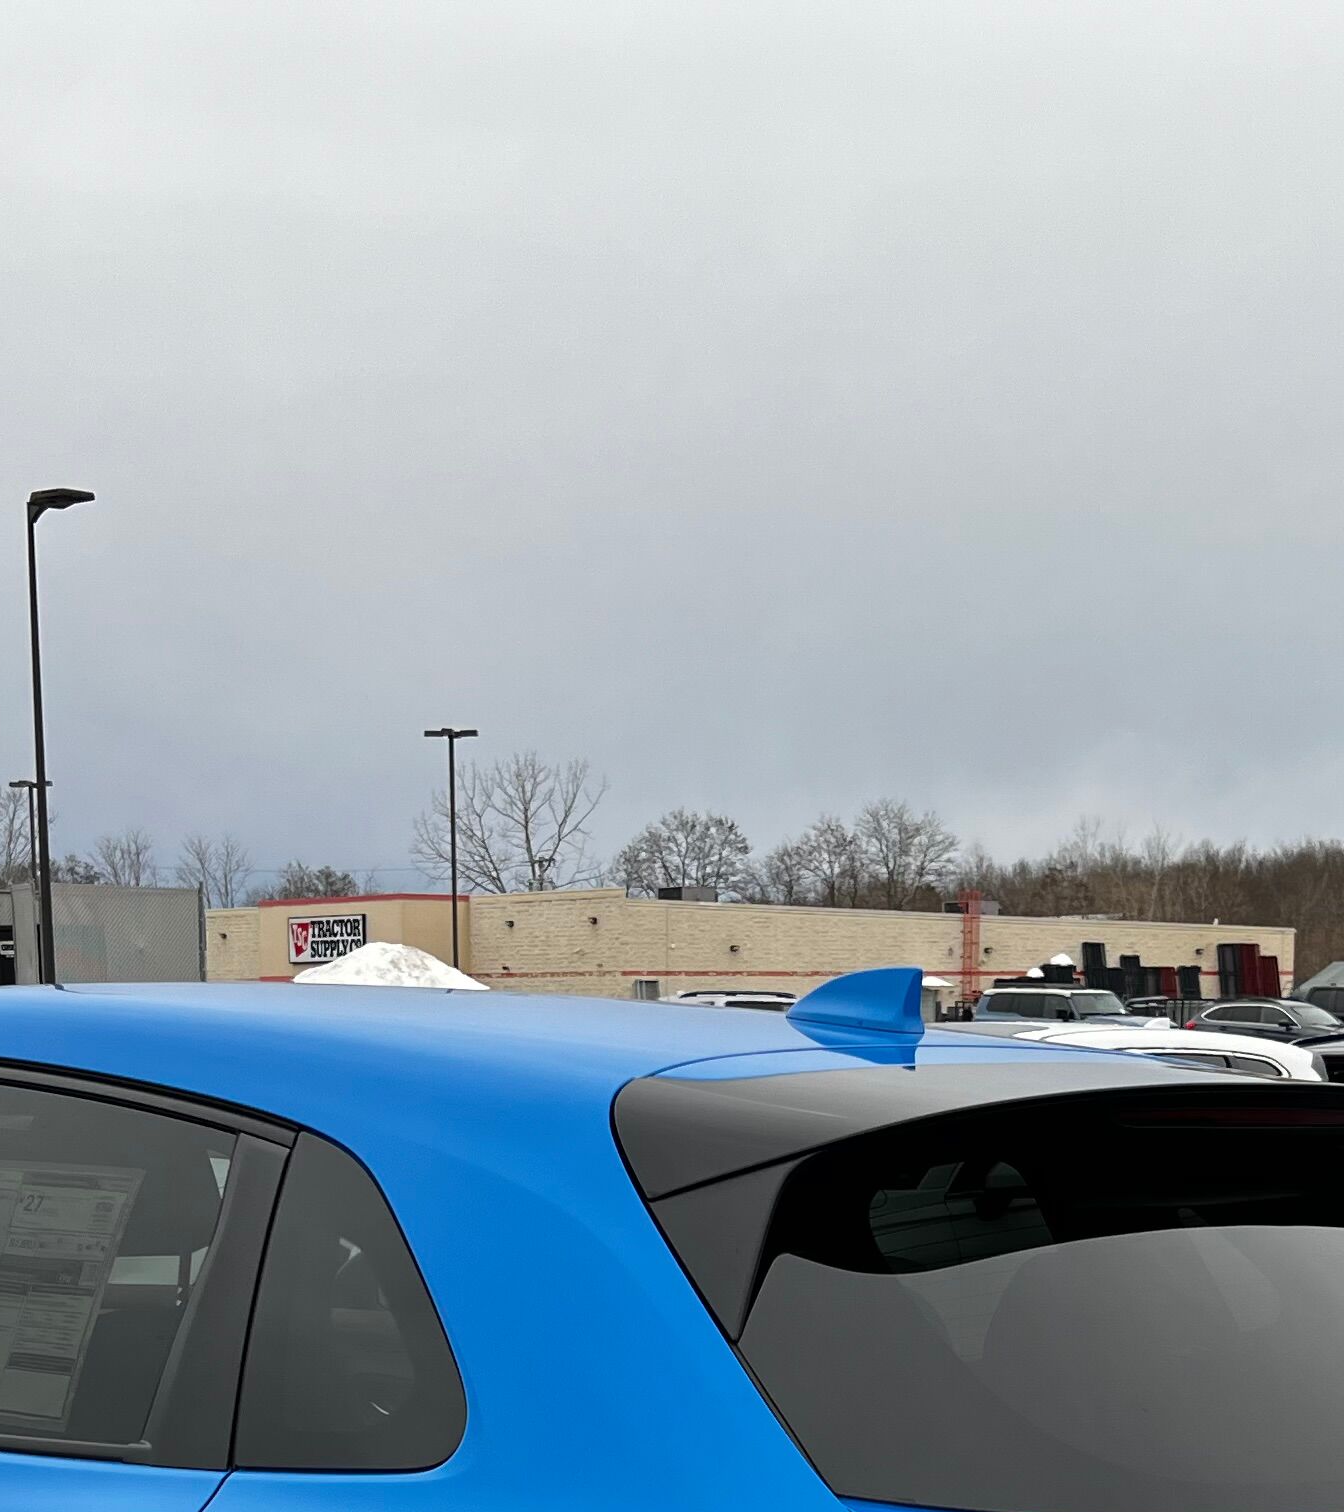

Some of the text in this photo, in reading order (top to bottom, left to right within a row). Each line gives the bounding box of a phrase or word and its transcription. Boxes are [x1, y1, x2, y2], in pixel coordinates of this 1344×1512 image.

[291, 924, 308, 951] TSC
[310, 918, 361, 938] TRACTOR
[310, 939, 348, 958] SUPPLY
